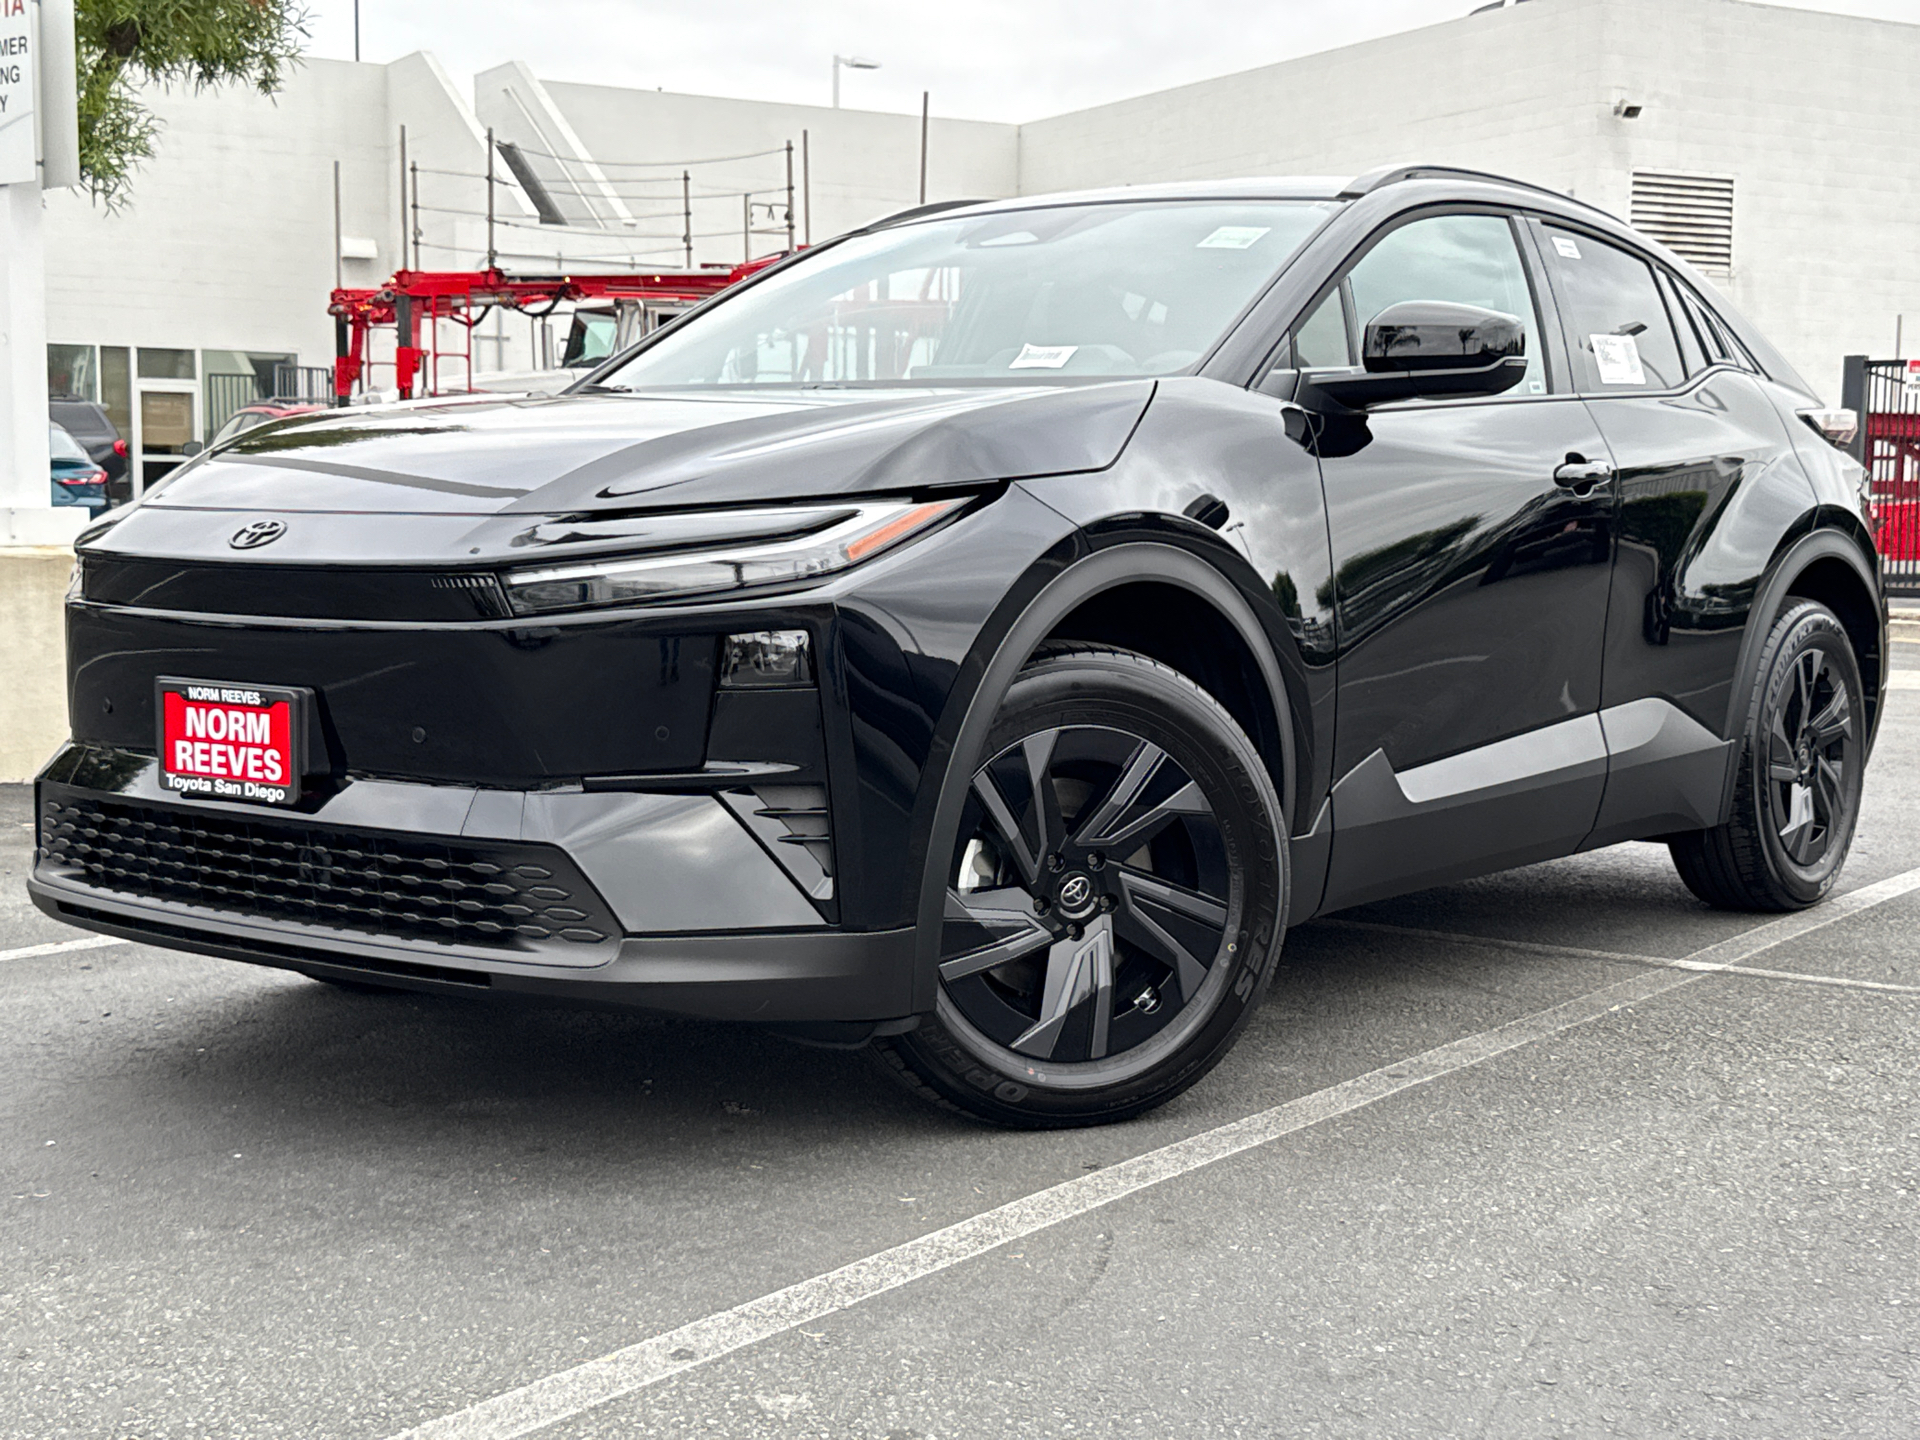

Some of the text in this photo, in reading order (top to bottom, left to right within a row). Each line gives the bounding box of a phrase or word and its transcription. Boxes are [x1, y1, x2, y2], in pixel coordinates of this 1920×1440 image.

[0, 0, 25, 17] TA
[0, 35, 28, 56] MER
[0, 64, 20, 85] NG
[187, 686, 261, 705] NORM REEVES
[185, 706, 270, 745] NORM
[175, 740, 282, 781] REEVES
[166, 773, 285, 803] Toyota San Diego
[918, 1024, 1031, 1103] OPEN
